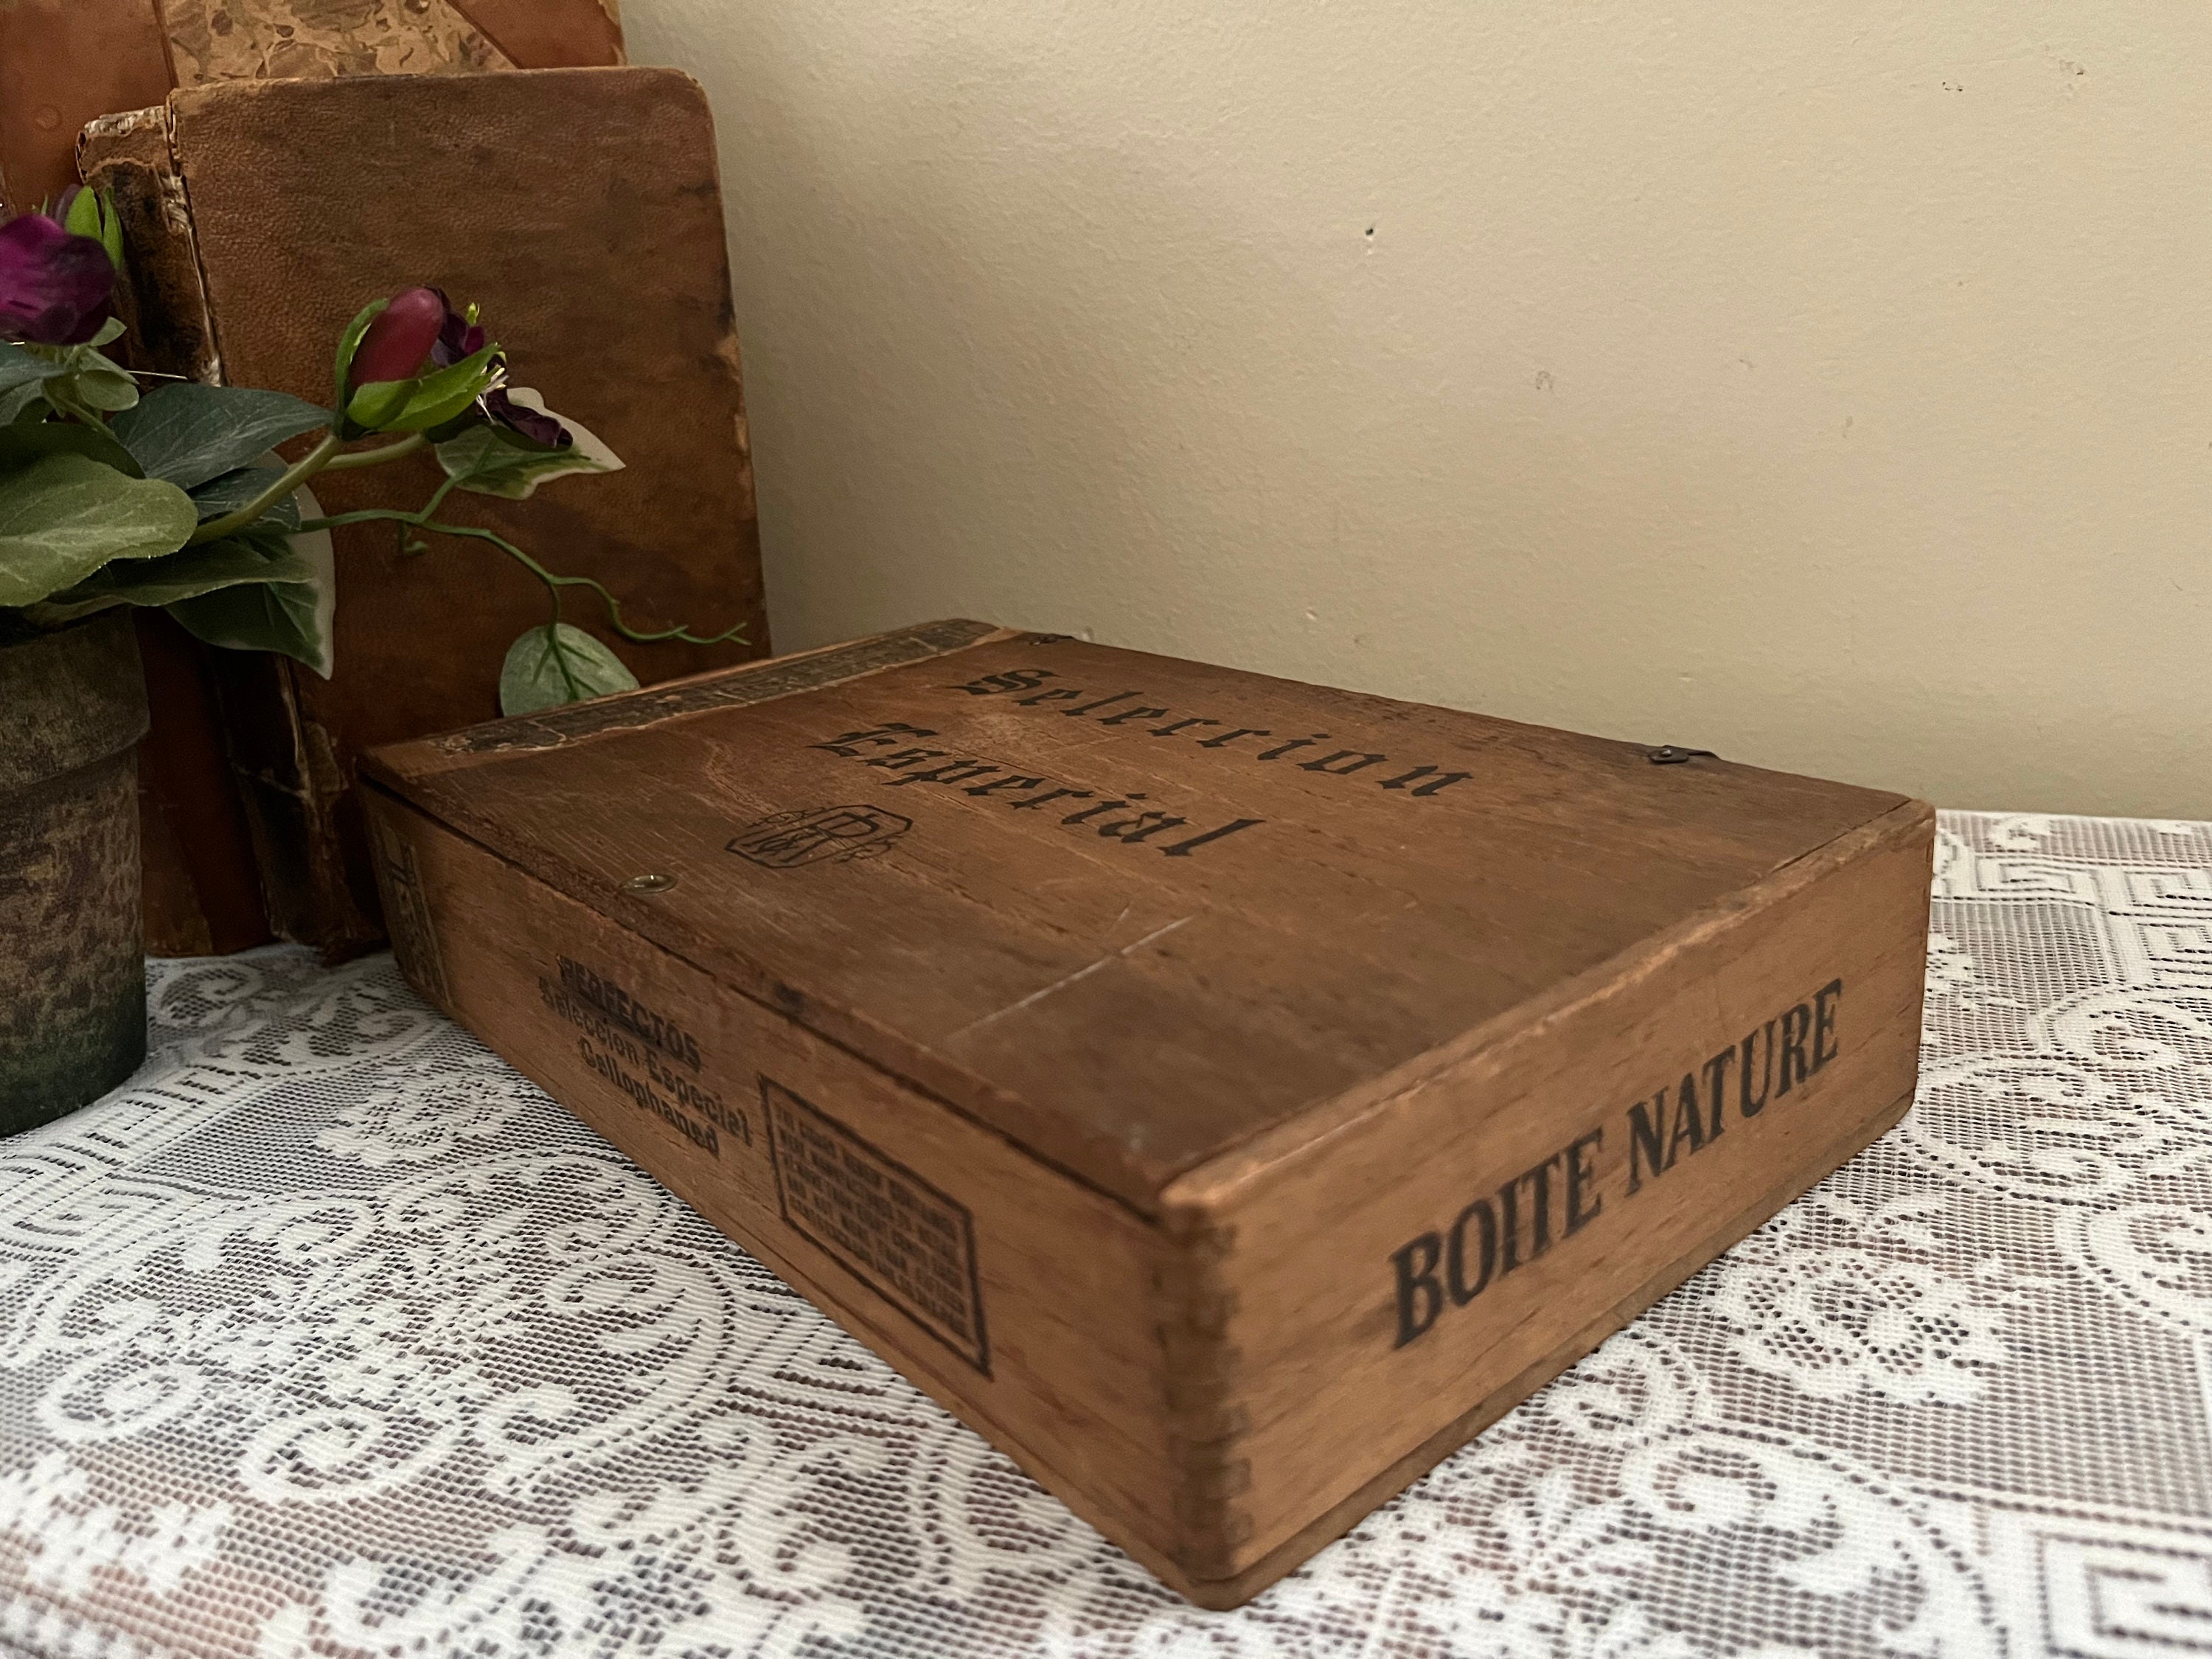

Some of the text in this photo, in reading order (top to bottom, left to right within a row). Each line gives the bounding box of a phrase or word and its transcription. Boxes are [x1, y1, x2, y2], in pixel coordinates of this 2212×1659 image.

[810, 723, 1265, 857] Especial
[947, 668, 1474, 797] Seleccion
[558, 956, 701, 1072] PERFECTOS
[645, 1046, 752, 1147] Especial
[1388, 978, 1842, 1351] BOITE NATURE
